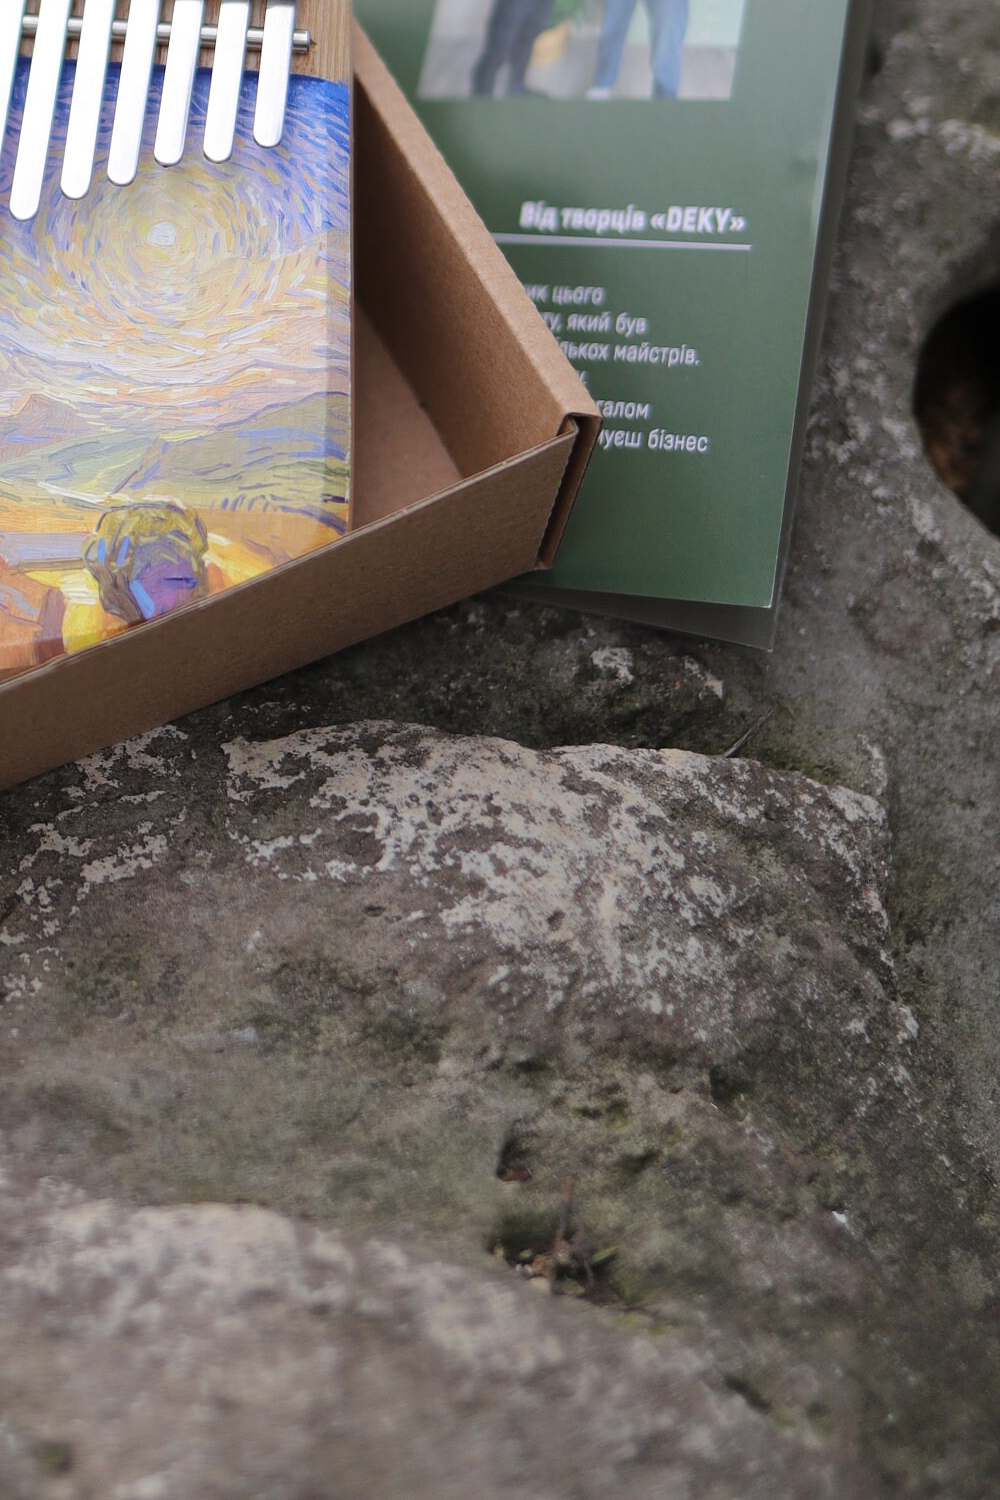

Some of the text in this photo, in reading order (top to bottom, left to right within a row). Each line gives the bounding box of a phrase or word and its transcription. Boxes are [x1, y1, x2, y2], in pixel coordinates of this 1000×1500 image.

[519, 200, 746, 234] Від творців «DEKY»
[525, 284, 605, 306] ик цього
[540, 311, 647, 338] ту, який був
[557, 337, 700, 368] лькох майстрів.
[595, 399, 650, 420] галом
[648, 428, 708, 454] бізнес
